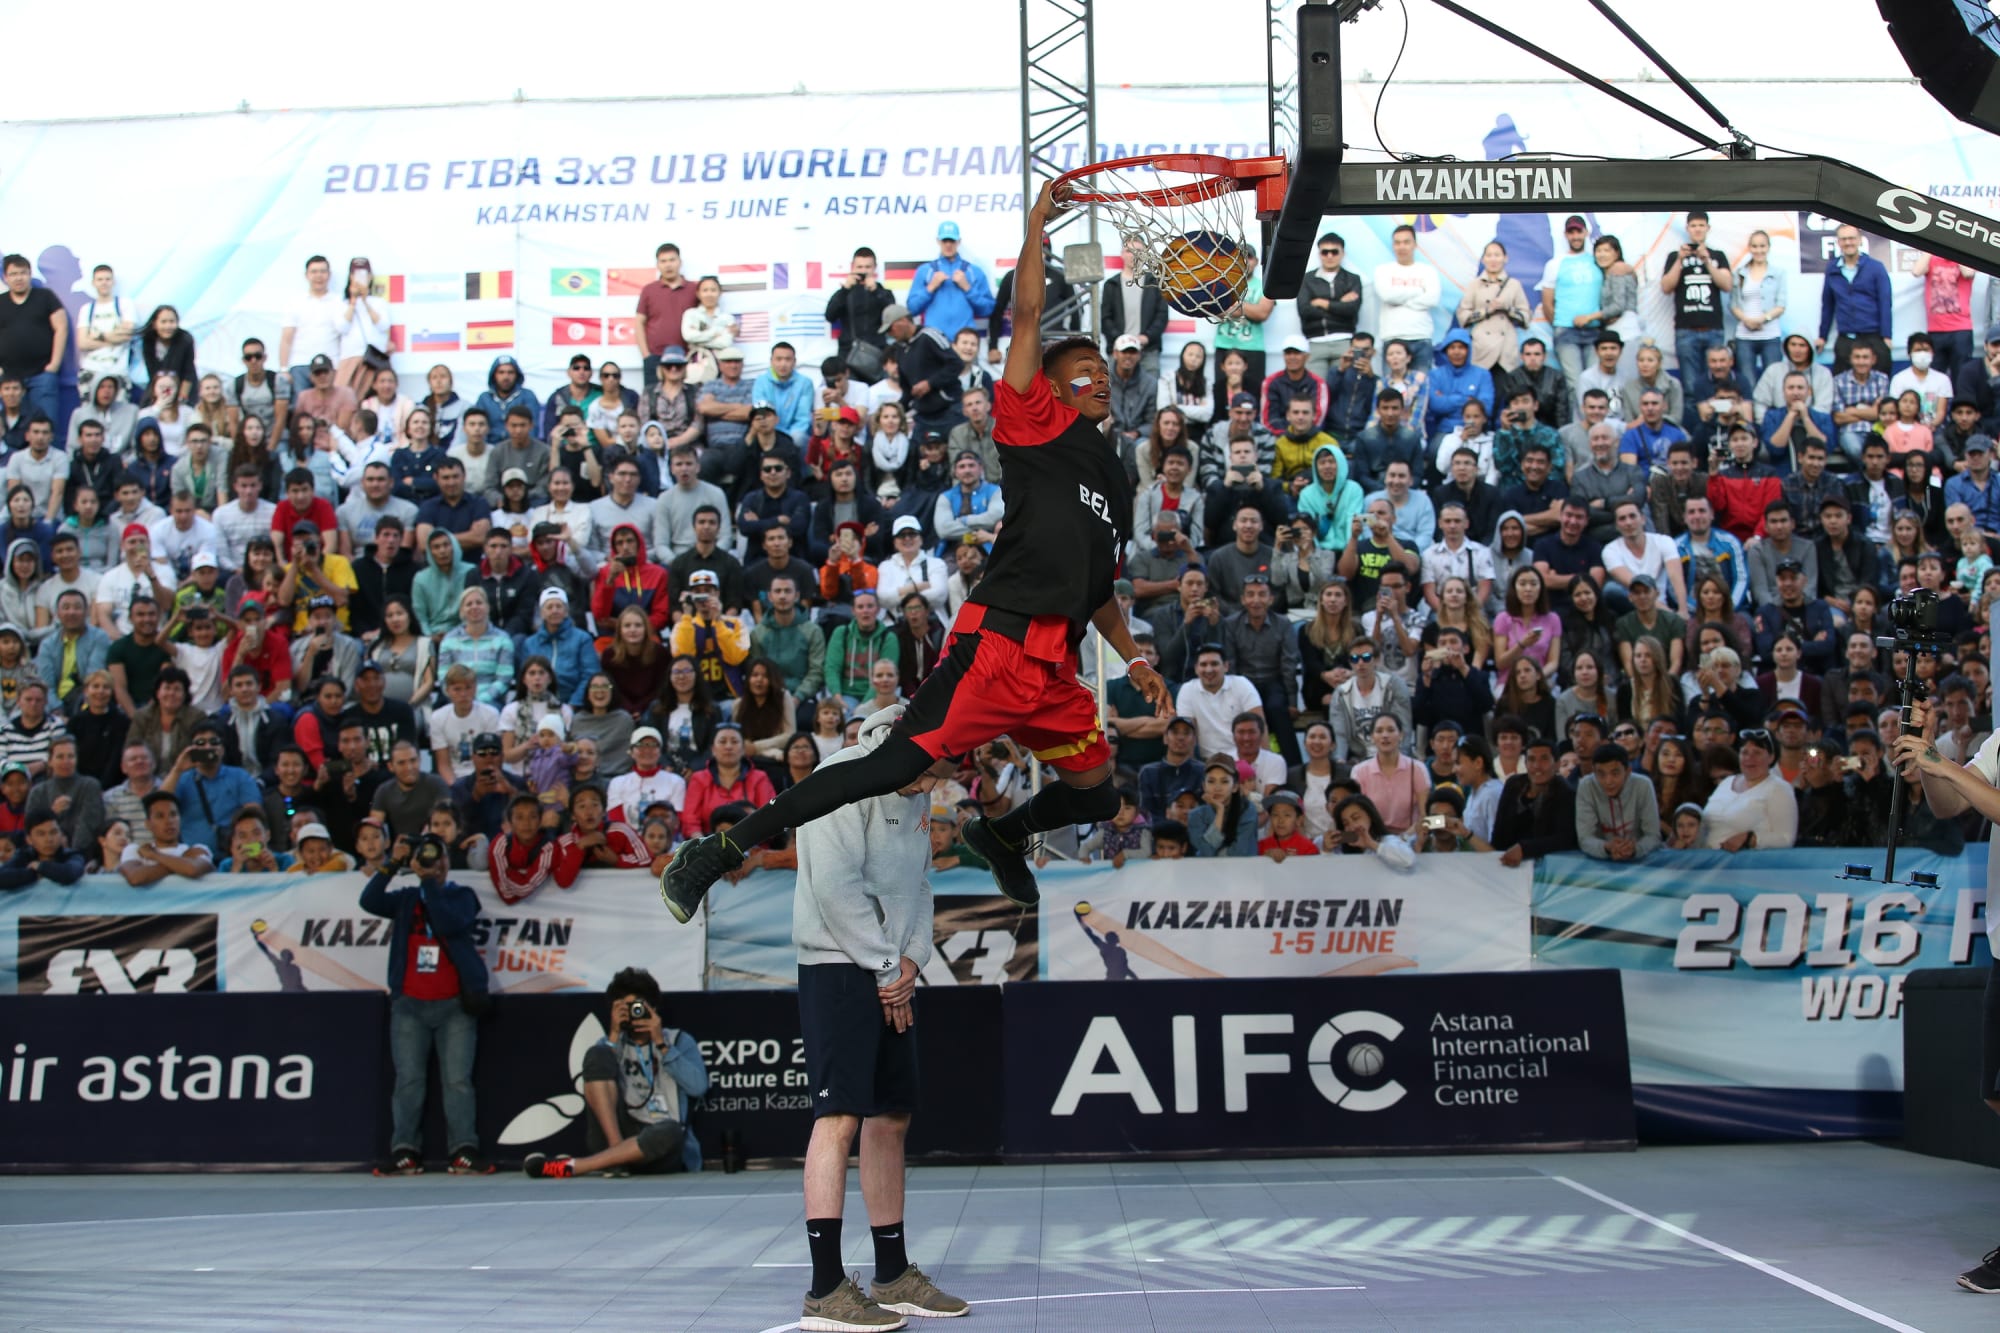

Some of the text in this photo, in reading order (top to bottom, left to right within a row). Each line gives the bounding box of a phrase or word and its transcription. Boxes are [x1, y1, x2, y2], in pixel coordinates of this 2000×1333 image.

[324, 162, 430, 194] 2016
[443, 157, 542, 190] FIBA
[555, 156, 636, 186] 3x3
[650, 151, 728, 184] U18
[742, 148, 887, 181] WORLD
[1376, 167, 1572, 201] KAZAKHSTAN
[1928, 184, 2000, 197] KAZAKH
[477, 202, 649, 225] KAZAKHSTAN
[726, 198, 787, 219] JUNE
[824, 196, 930, 216] ASTANA
[937, 193, 1024, 213] OPERA
[1126, 898, 1404, 930] KAZAKHSTAN
[1270, 930, 1397, 955] 1-5 JUNE
[1673, 893, 1925, 969] 2016
[492, 949, 566, 972] JUNE
[1430, 1011, 1514, 1033] Astana
[697, 1038, 781, 1066] EXPO
[1431, 1030, 1590, 1057] International
[0, 1043, 315, 1101] ir astana
[1050, 1010, 1408, 1116] AIFC
[1433, 1057, 1548, 1081] Financial
[708, 1071, 778, 1088] Future
[1434, 1084, 1519, 1106] Centre
